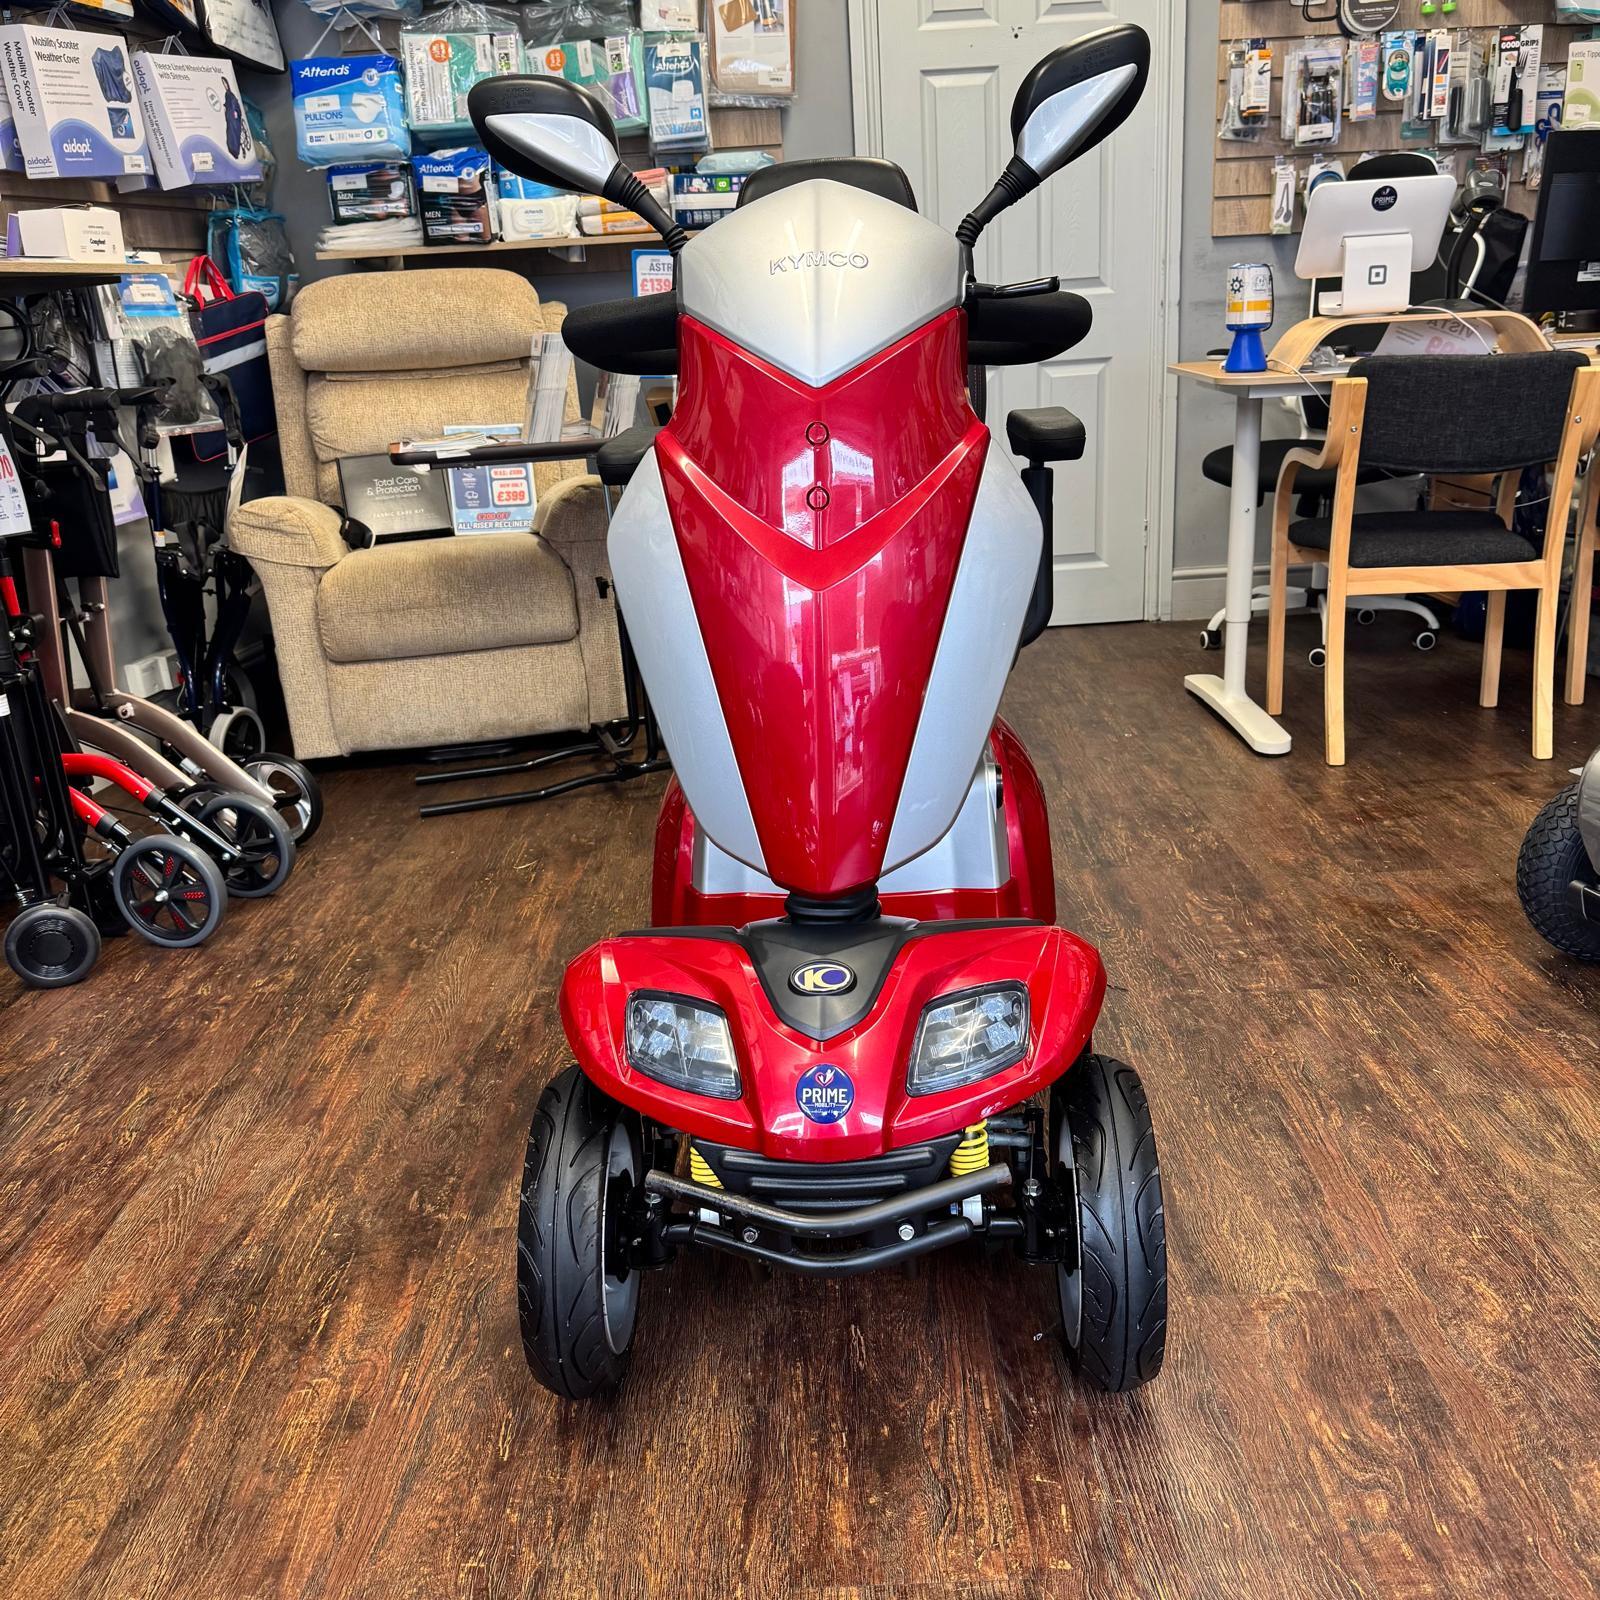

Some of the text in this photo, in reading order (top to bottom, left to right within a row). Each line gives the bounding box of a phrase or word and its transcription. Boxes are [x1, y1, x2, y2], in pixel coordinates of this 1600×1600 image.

[31, 36, 80, 50] Mobility Scooter
[1501, 40, 1520, 49] GOOD
[35, 51, 80, 65] Weather Cover
[299, 64, 351, 78] Attends
[655, 61, 690, 72] Attends
[3, 42, 25, 112] Weather Cover
[14, 41, 37, 117] Mobility Scooter
[133, 59, 151, 95] aidapt
[304, 111, 344, 121] PULL-ONS
[63, 138, 92, 156] aidapt
[27, 156, 52, 166] aidapt
[419, 163, 454, 174] Attends
[337, 192, 354, 201] MEN
[1374, 195, 1396, 204] PRIME
[425, 211, 441, 219] MEN
[769, 250, 869, 276] KYMCO
[640, 278, 671, 293] £139
[373, 476, 419, 487] Total Care
[367, 484, 421, 496] & Protection
[497, 490, 526, 502] £399
[473, 521, 494, 529] RISER
[494, 519, 533, 528] RECLINERS
[802, 1087, 848, 1104] PRIME
